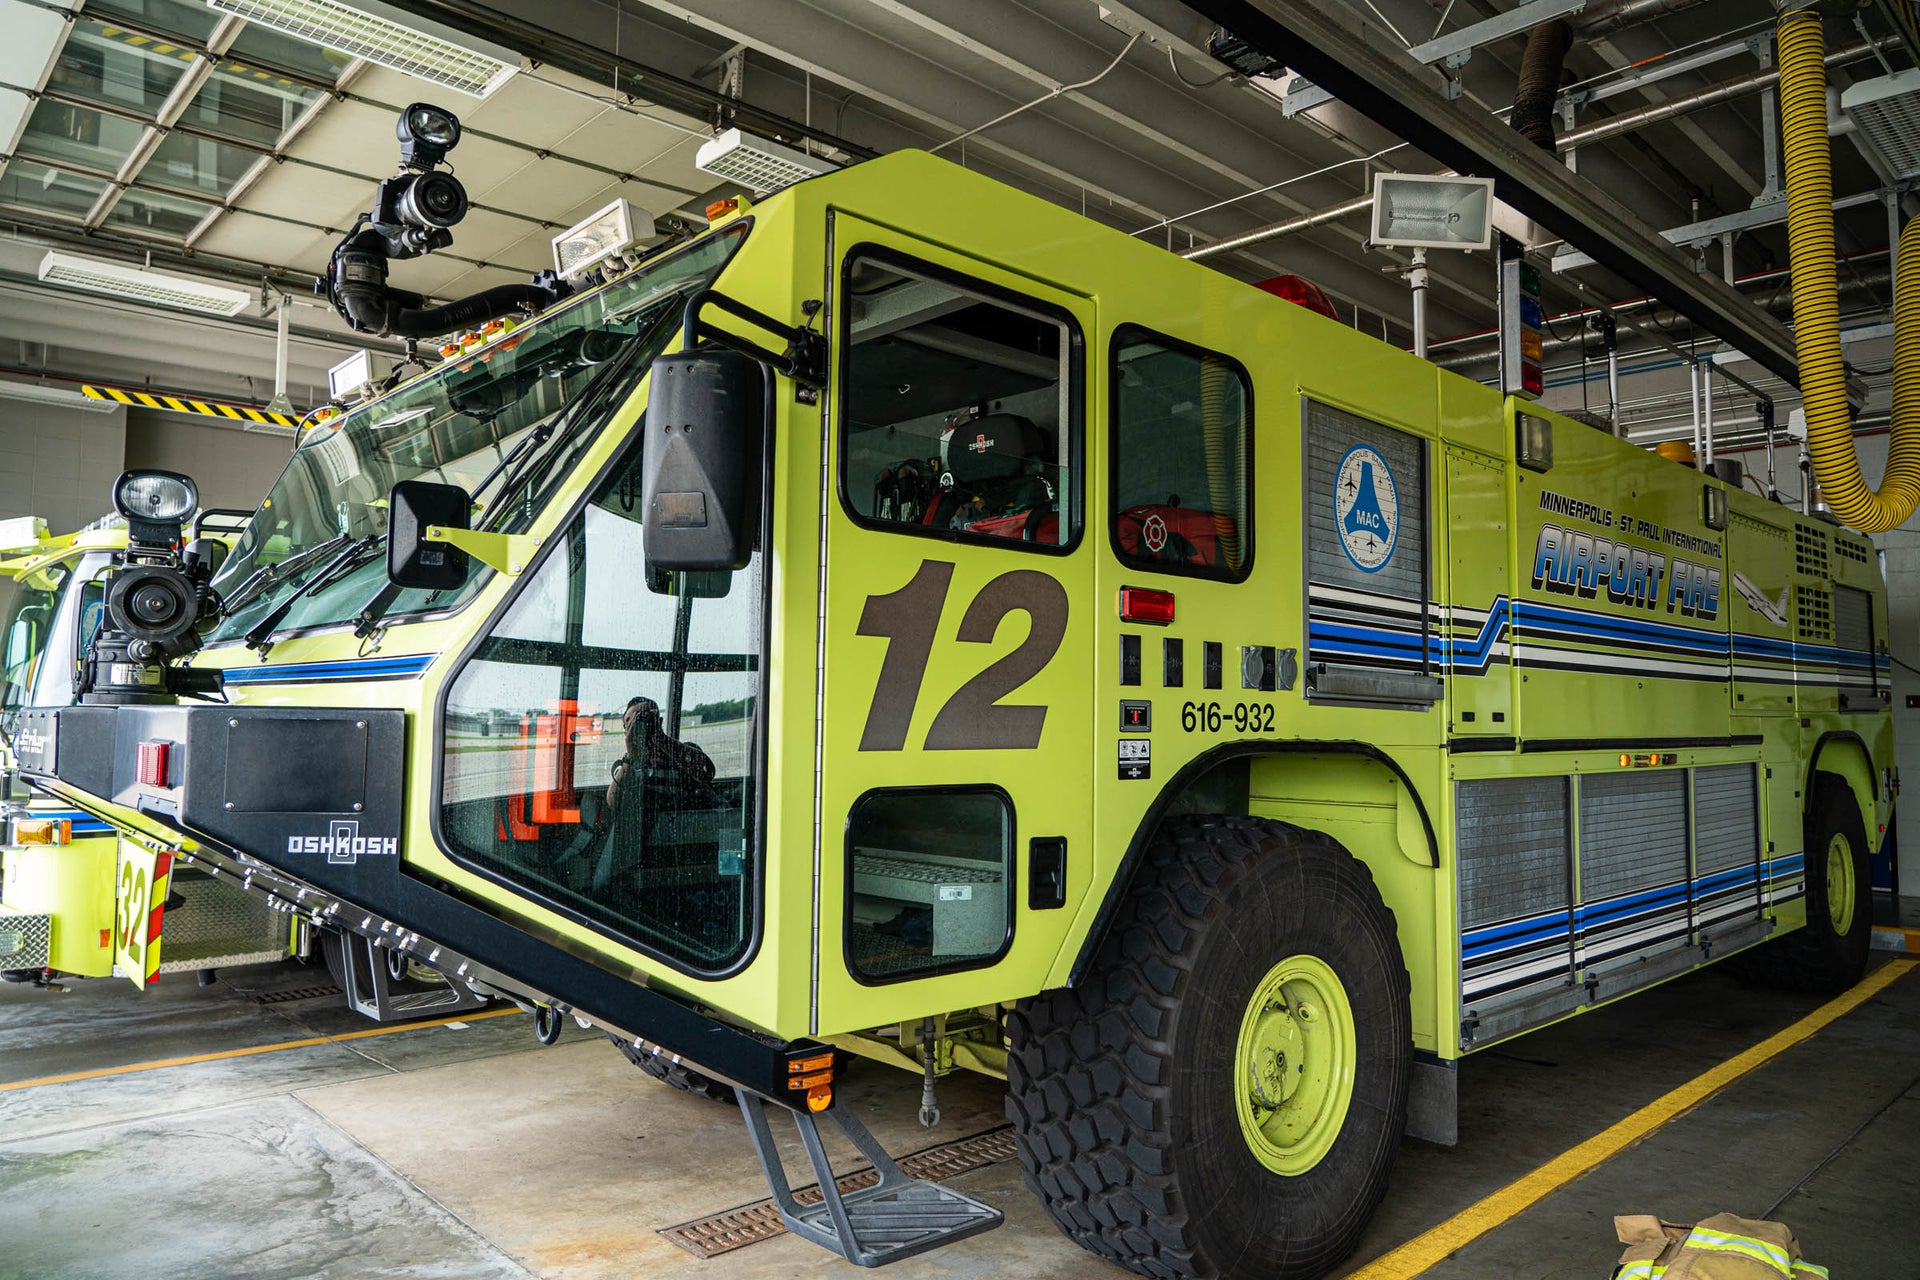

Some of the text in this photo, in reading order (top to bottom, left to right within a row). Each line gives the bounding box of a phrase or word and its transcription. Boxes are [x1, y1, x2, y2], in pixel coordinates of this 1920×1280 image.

[1339, 451, 1369, 489] MINNEAPOLIS
[1372, 454, 1386, 475] SAINT
[1356, 509, 1380, 529] MAC
[1540, 490, 1613, 527] MINNEAPOLIS
[1620, 515, 1634, 534] ST.
[1637, 520, 1660, 541] PAUL
[1663, 528, 1722, 559] INTERNATIONAL
[1532, 522, 1721, 622] AIRPORT FIRE
[856, 559, 1069, 751] 12
[1182, 701, 1275, 733] 616-932
[288, 835, 398, 855] OSHKOSH
[118, 859, 146, 965] 32
